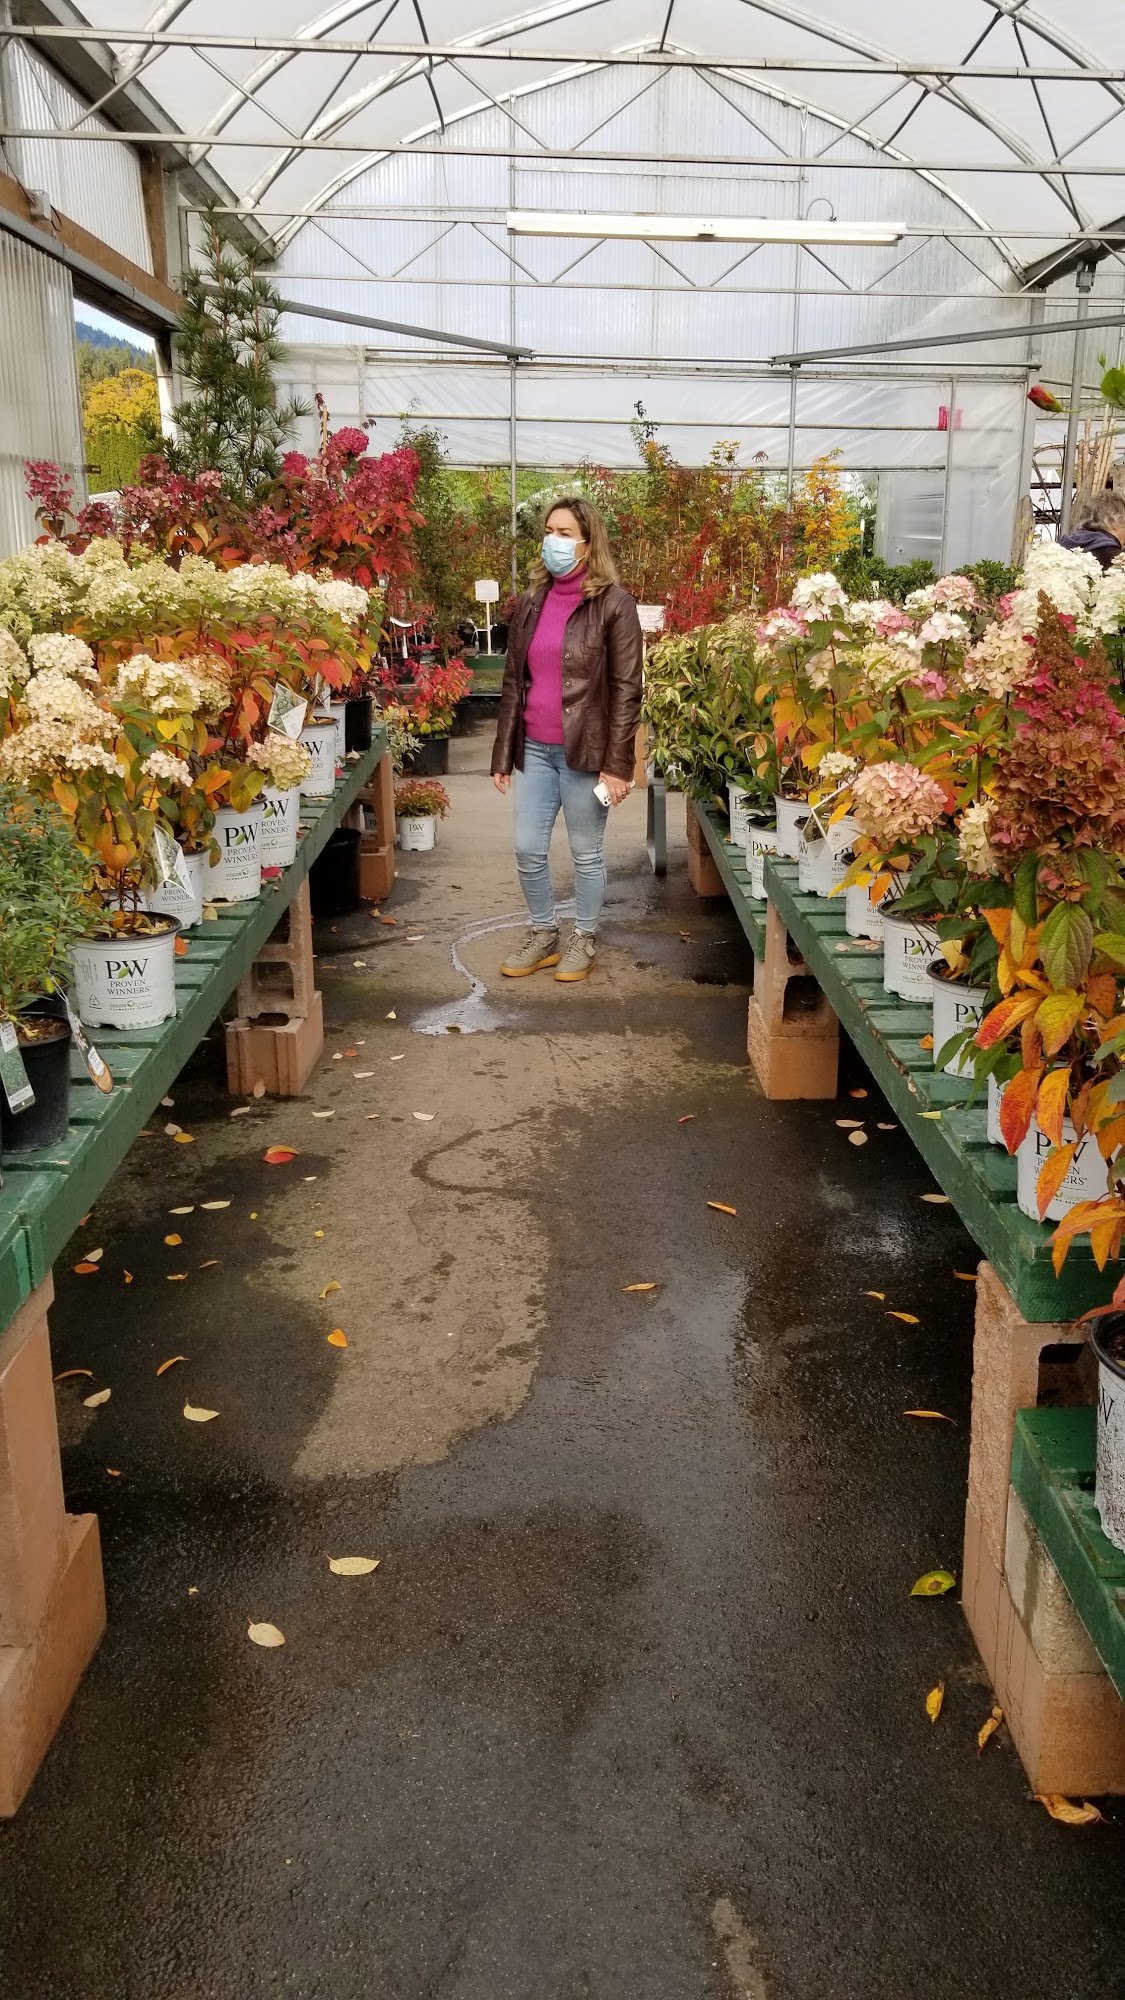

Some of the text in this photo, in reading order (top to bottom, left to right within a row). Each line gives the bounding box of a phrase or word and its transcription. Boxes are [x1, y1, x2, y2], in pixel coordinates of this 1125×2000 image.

[298, 741, 323, 756] W
[261, 819, 287, 828] ROVEN
[409, 824, 424, 832] PW
[222, 823, 259, 847] PW
[261, 826, 290, 835] INNERS
[227, 845, 257, 856] PROVEN
[224, 853, 259, 864] WINNERS
[903, 937, 940, 956] PW
[904, 956, 935, 965] PROVEN
[105, 958, 150, 980] PW
[902, 962, 928, 971] WINNE
[110, 979, 146, 988] PROVEN
[107, 986, 150, 995] WINNERS
[1037, 1158, 1081, 1175] PEN
[1033, 1166, 1086, 1185] WERS
